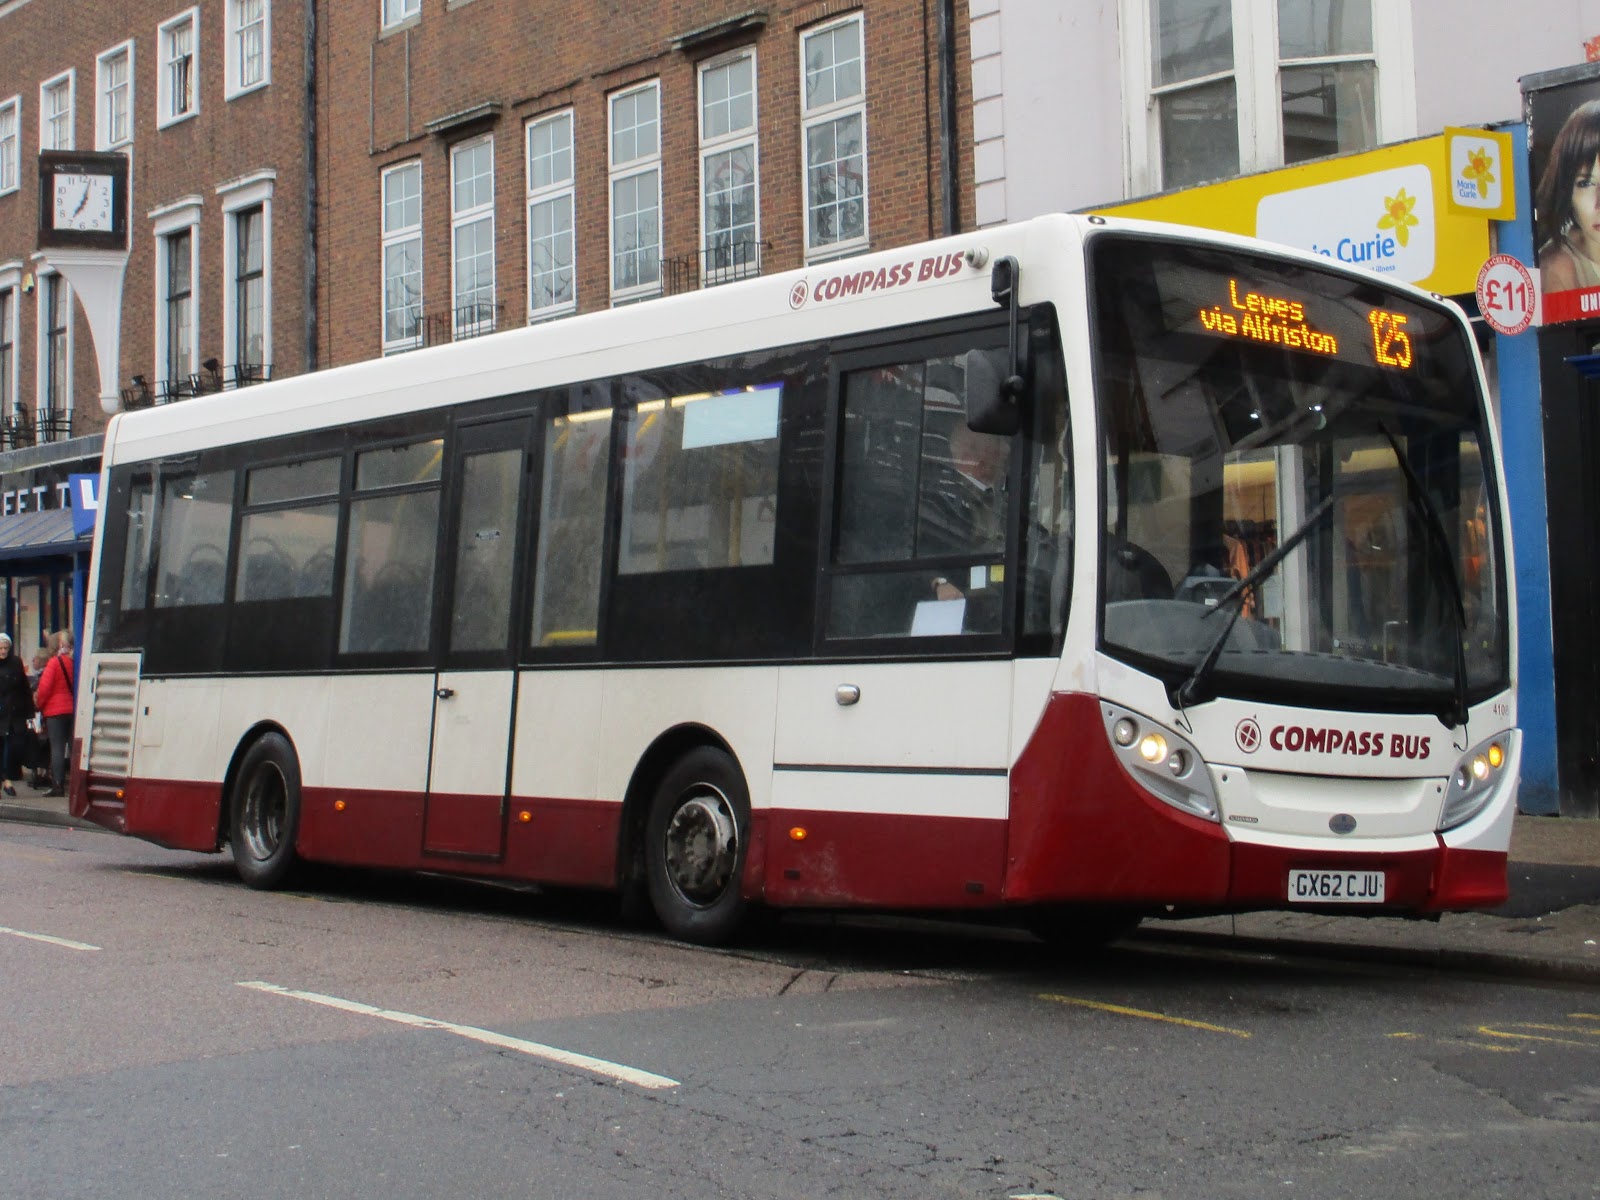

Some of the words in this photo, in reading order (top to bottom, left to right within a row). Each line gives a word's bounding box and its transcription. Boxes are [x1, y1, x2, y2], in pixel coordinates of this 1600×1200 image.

[68, 176, 75, 185] 11
[1457, 179, 1476, 190] Marie
[58, 186, 67, 195] 10
[102, 186, 108, 196] 2
[1459, 188, 1476, 199] Curie
[56, 197, 63, 206] 9
[103, 198, 110, 208] 3
[59, 209, 66, 218] 8
[100, 210, 106, 219] 4
[68, 219, 73, 227] 7
[79, 221, 86, 230] 6
[92, 219, 99, 228] 5
[1336, 233, 1395, 263] Curie
[813, 262, 914, 302] COMPASS
[917, 251, 965, 282] BUS
[1230, 279, 1304, 322] Lewes
[1485, 279, 1527, 312] £11
[1580, 292, 1600, 312] UN
[1200, 306, 1237, 335] via
[1241, 313, 1337, 354] Alfriston
[1368, 310, 1412, 368] 125
[1269, 725, 1384, 756] COMPASS
[1390, 734, 1431, 760] BUS
[1296, 873, 1342, 897] GX62
[1347, 874, 1378, 897] CJU
